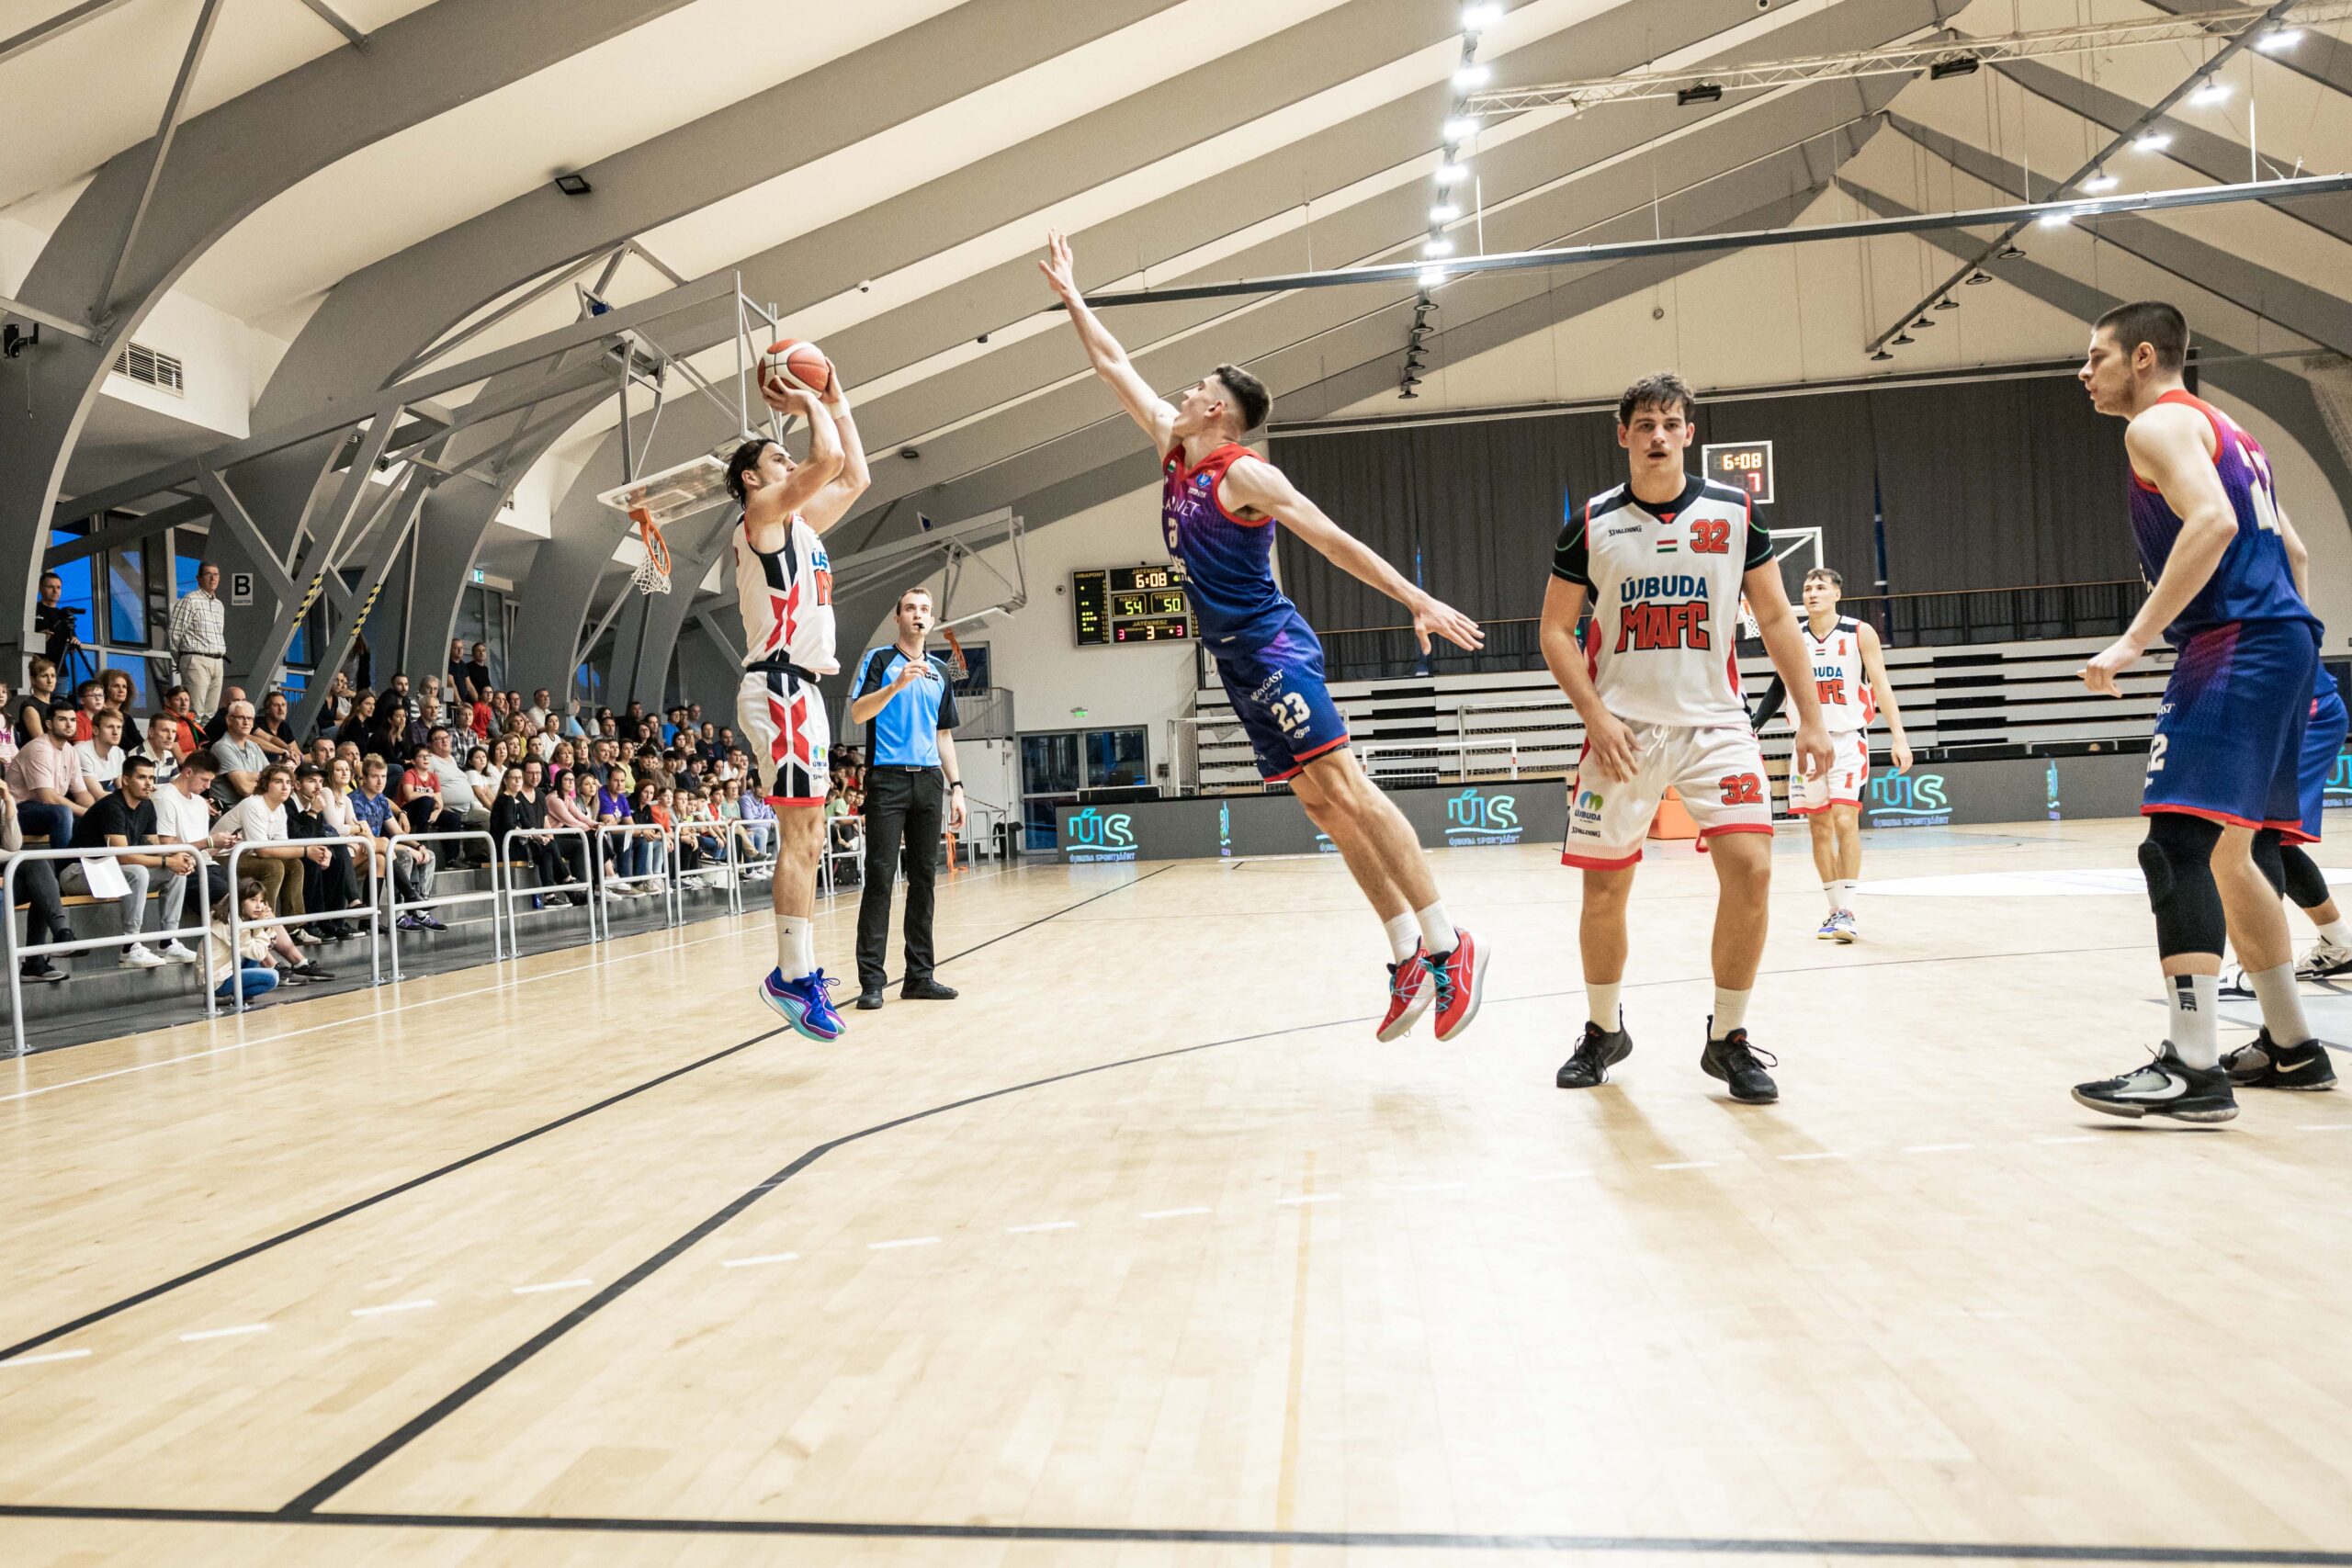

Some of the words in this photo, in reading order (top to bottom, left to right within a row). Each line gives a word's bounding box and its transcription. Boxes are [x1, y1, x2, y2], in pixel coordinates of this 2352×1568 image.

[1723, 453, 1762, 470] 6:08
[1747, 472, 1761, 491] 7
[1609, 525, 1642, 536] SPALDING
[1690, 519, 1730, 554] 32
[234, 575, 251, 595] B
[1136, 572, 1167, 588] 6:08
[1621, 575, 1708, 603] ÚJBUDA
[1125, 601, 1142, 615] 54
[1164, 598, 1181, 613] 50
[1118, 629, 1125, 640] 3
[1146, 626, 1155, 640] 3
[1176, 625, 1183, 637] 3
[1614, 601, 1711, 654] MAFC
[1838, 638, 1847, 656] 1
[1271, 692, 1311, 732] 23
[2147, 733, 2168, 772] 2
[1845, 773, 1854, 788] 1
[1719, 773, 1763, 806] 32
[1575, 809, 1601, 821] ÚJBUDA
[1572, 827, 1600, 838] SPALDING
[2177, 991, 2197, 1011] NIKE
